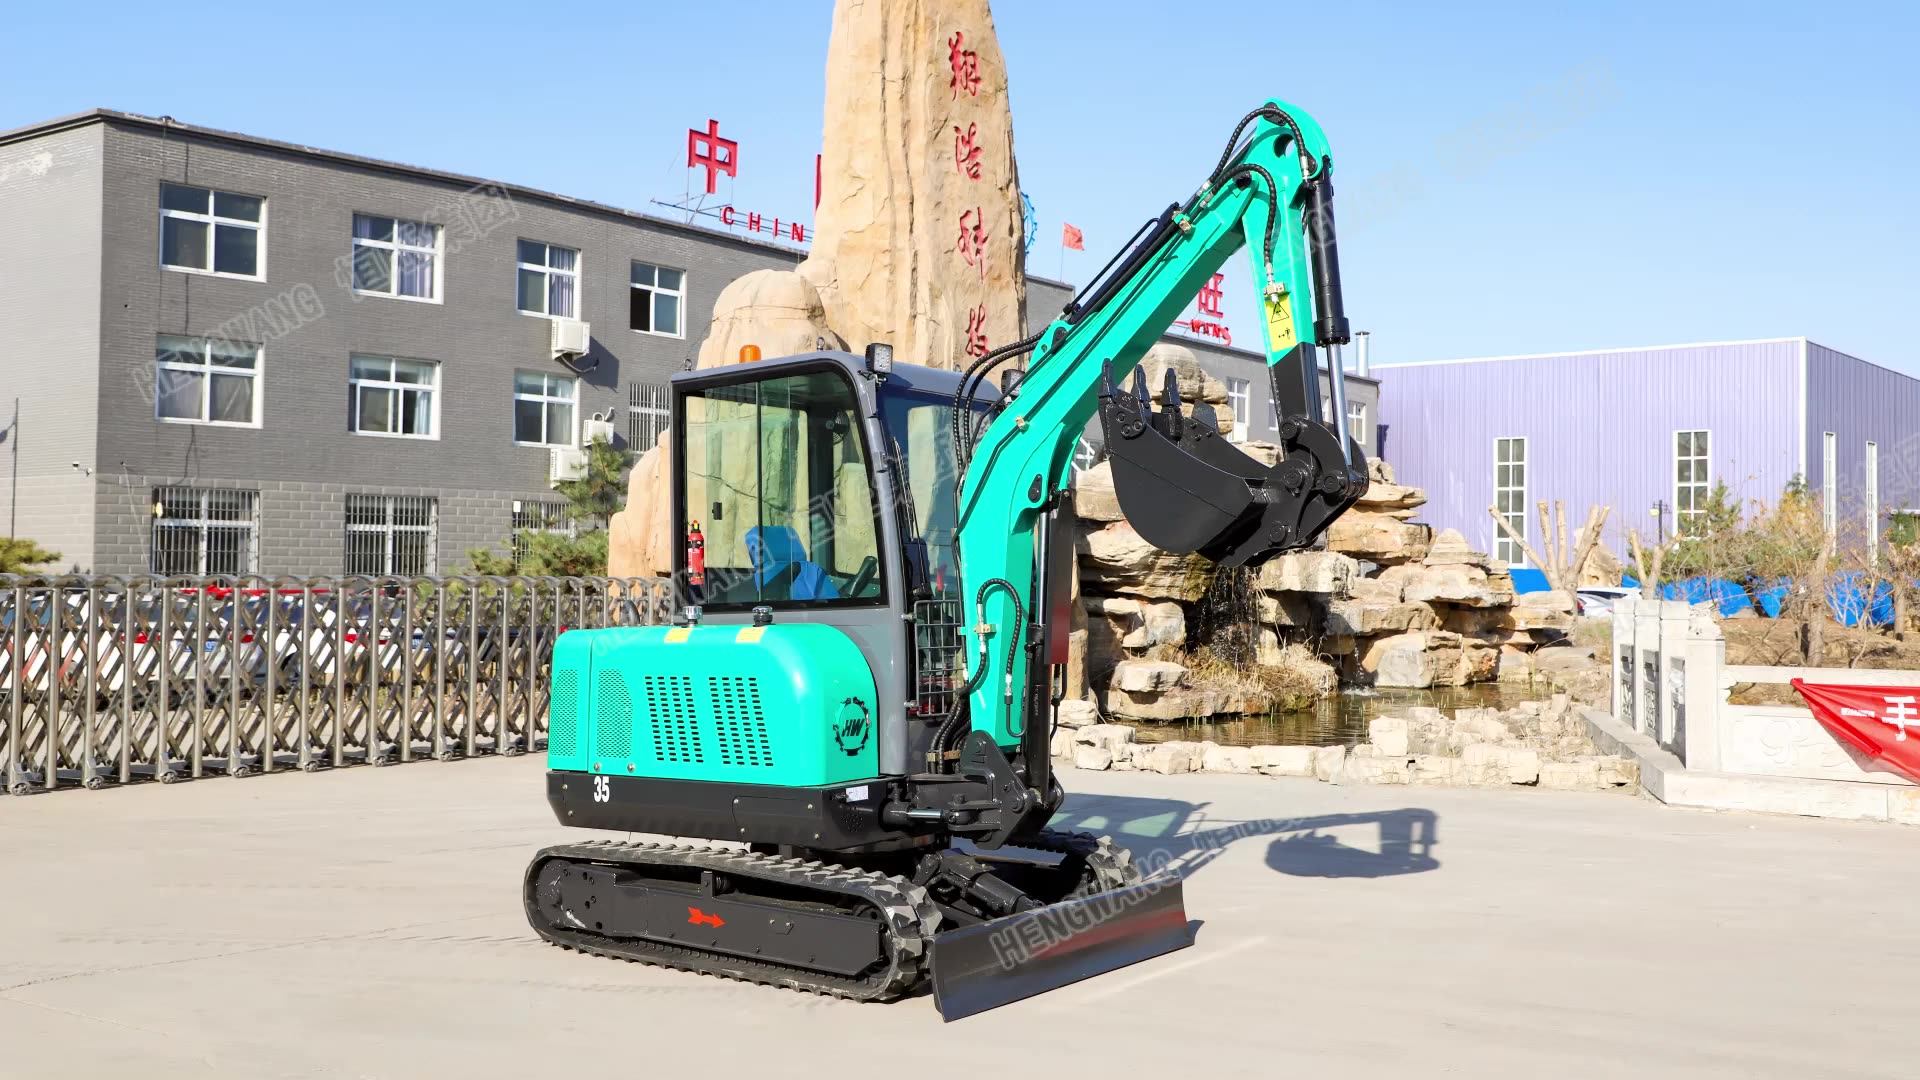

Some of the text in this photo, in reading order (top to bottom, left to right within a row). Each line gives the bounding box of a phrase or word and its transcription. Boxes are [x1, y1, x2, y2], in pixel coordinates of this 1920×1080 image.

[688, 119, 738, 194] 中
[721, 206, 804, 241] CHIN
[841, 718, 865, 737] HW
[593, 775, 610, 803] 35
